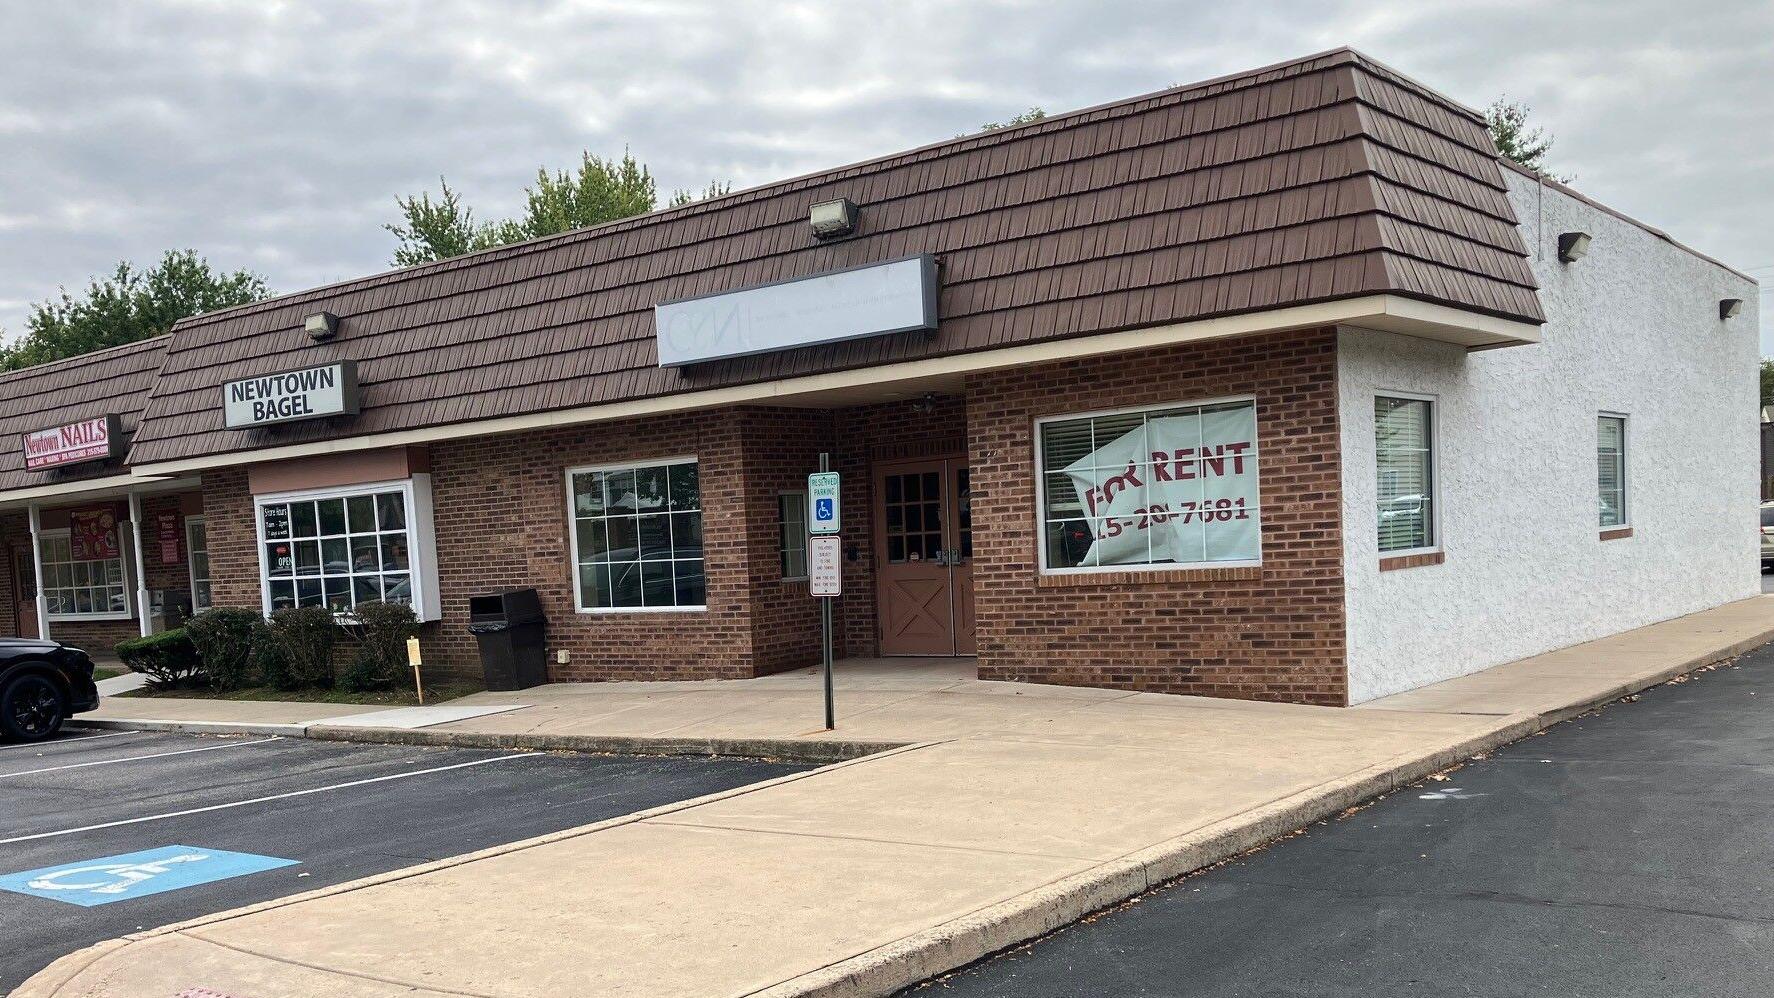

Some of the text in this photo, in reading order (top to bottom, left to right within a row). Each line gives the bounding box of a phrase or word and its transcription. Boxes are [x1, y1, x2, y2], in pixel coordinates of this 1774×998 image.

[231, 367, 334, 403] NEWTOWN
[252, 394, 314, 421] BAGEL
[24, 419, 107, 456] Newtown NAILS
[1151, 441, 1251, 483] RENT
[812, 477, 838, 486] RESERVED
[814, 487, 835, 496] PARKING
[264, 508, 276, 518] Store
[278, 556, 292, 567] OPEN
